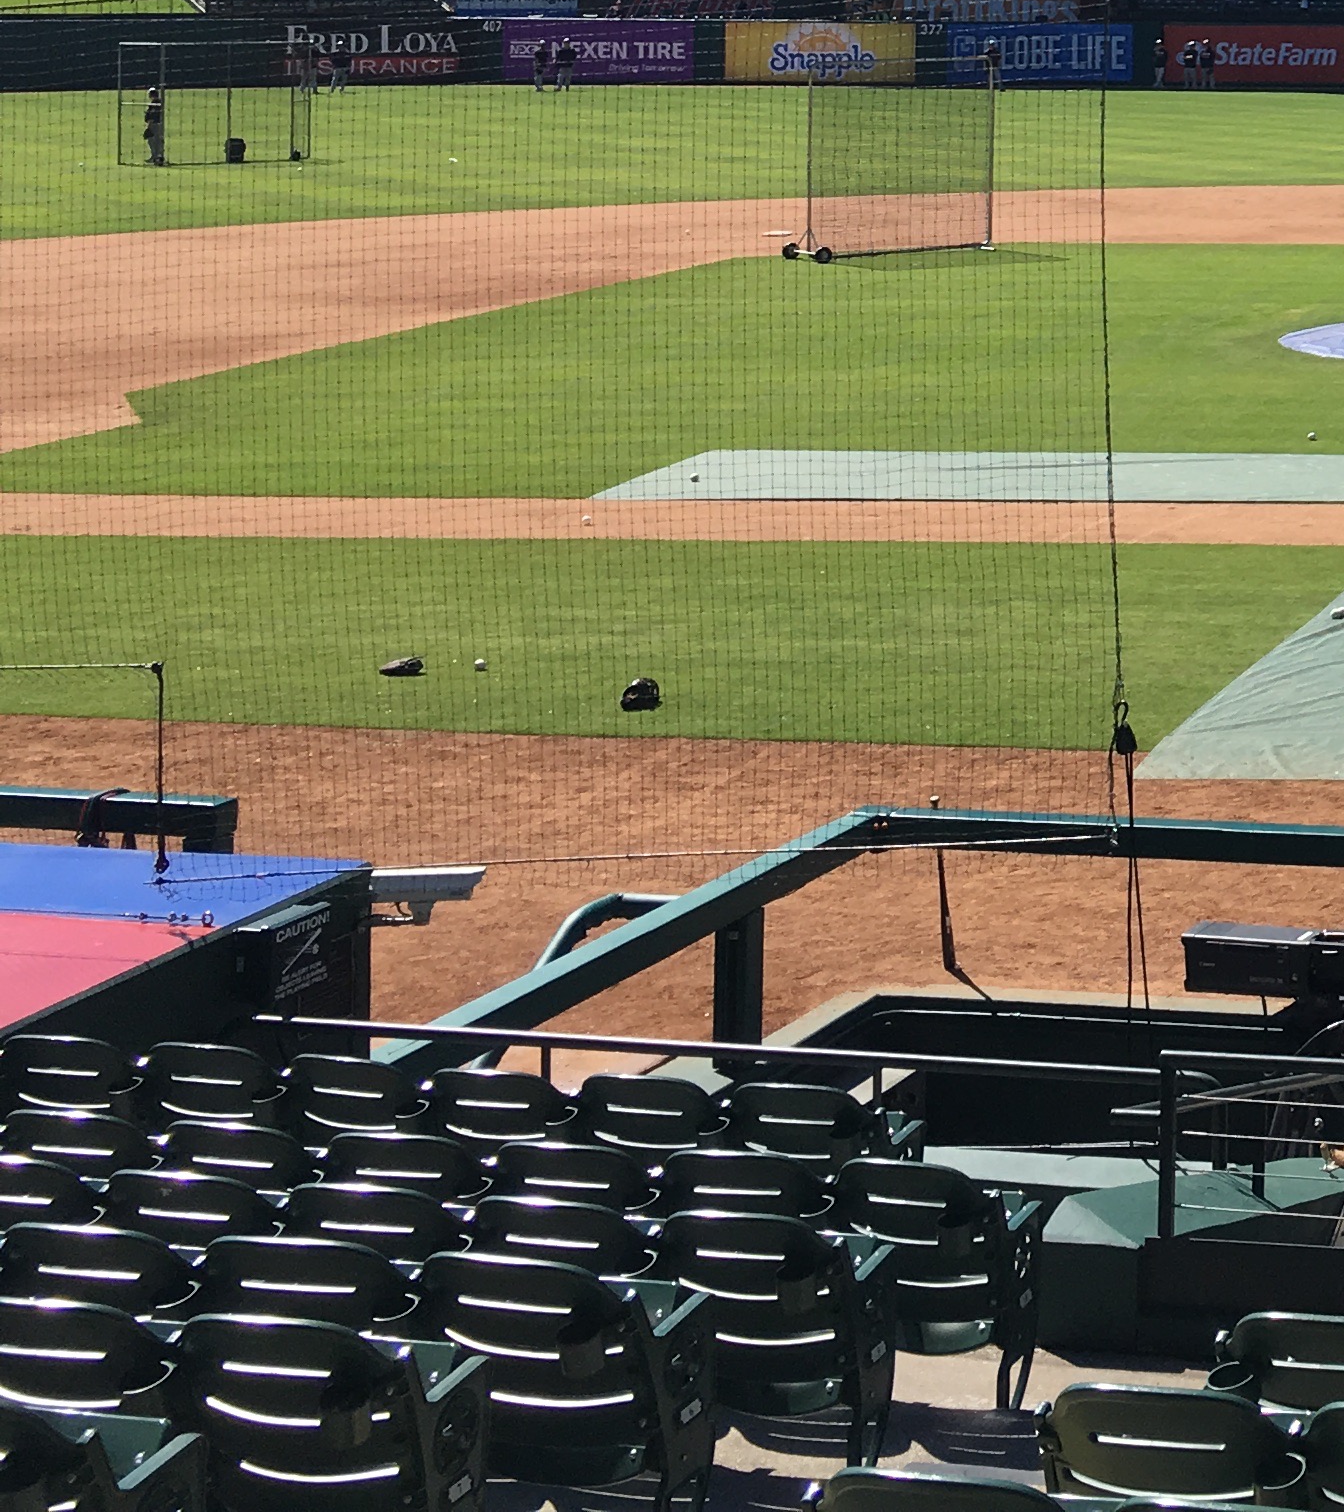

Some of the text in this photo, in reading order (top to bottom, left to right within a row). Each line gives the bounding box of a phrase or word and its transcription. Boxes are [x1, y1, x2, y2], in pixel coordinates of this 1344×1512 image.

[482, 21, 503, 32] 407
[920, 23, 944, 35] 377
[378, 24, 459, 55] LOYA
[634, 41, 687, 60] TIRE
[1071, 33, 1127, 70] LIFE
[608, 64, 688, 74] Driving Tomorrow
[769, 43, 877, 79] Snapple
[276, 910, 331, 944] CAUTION!
